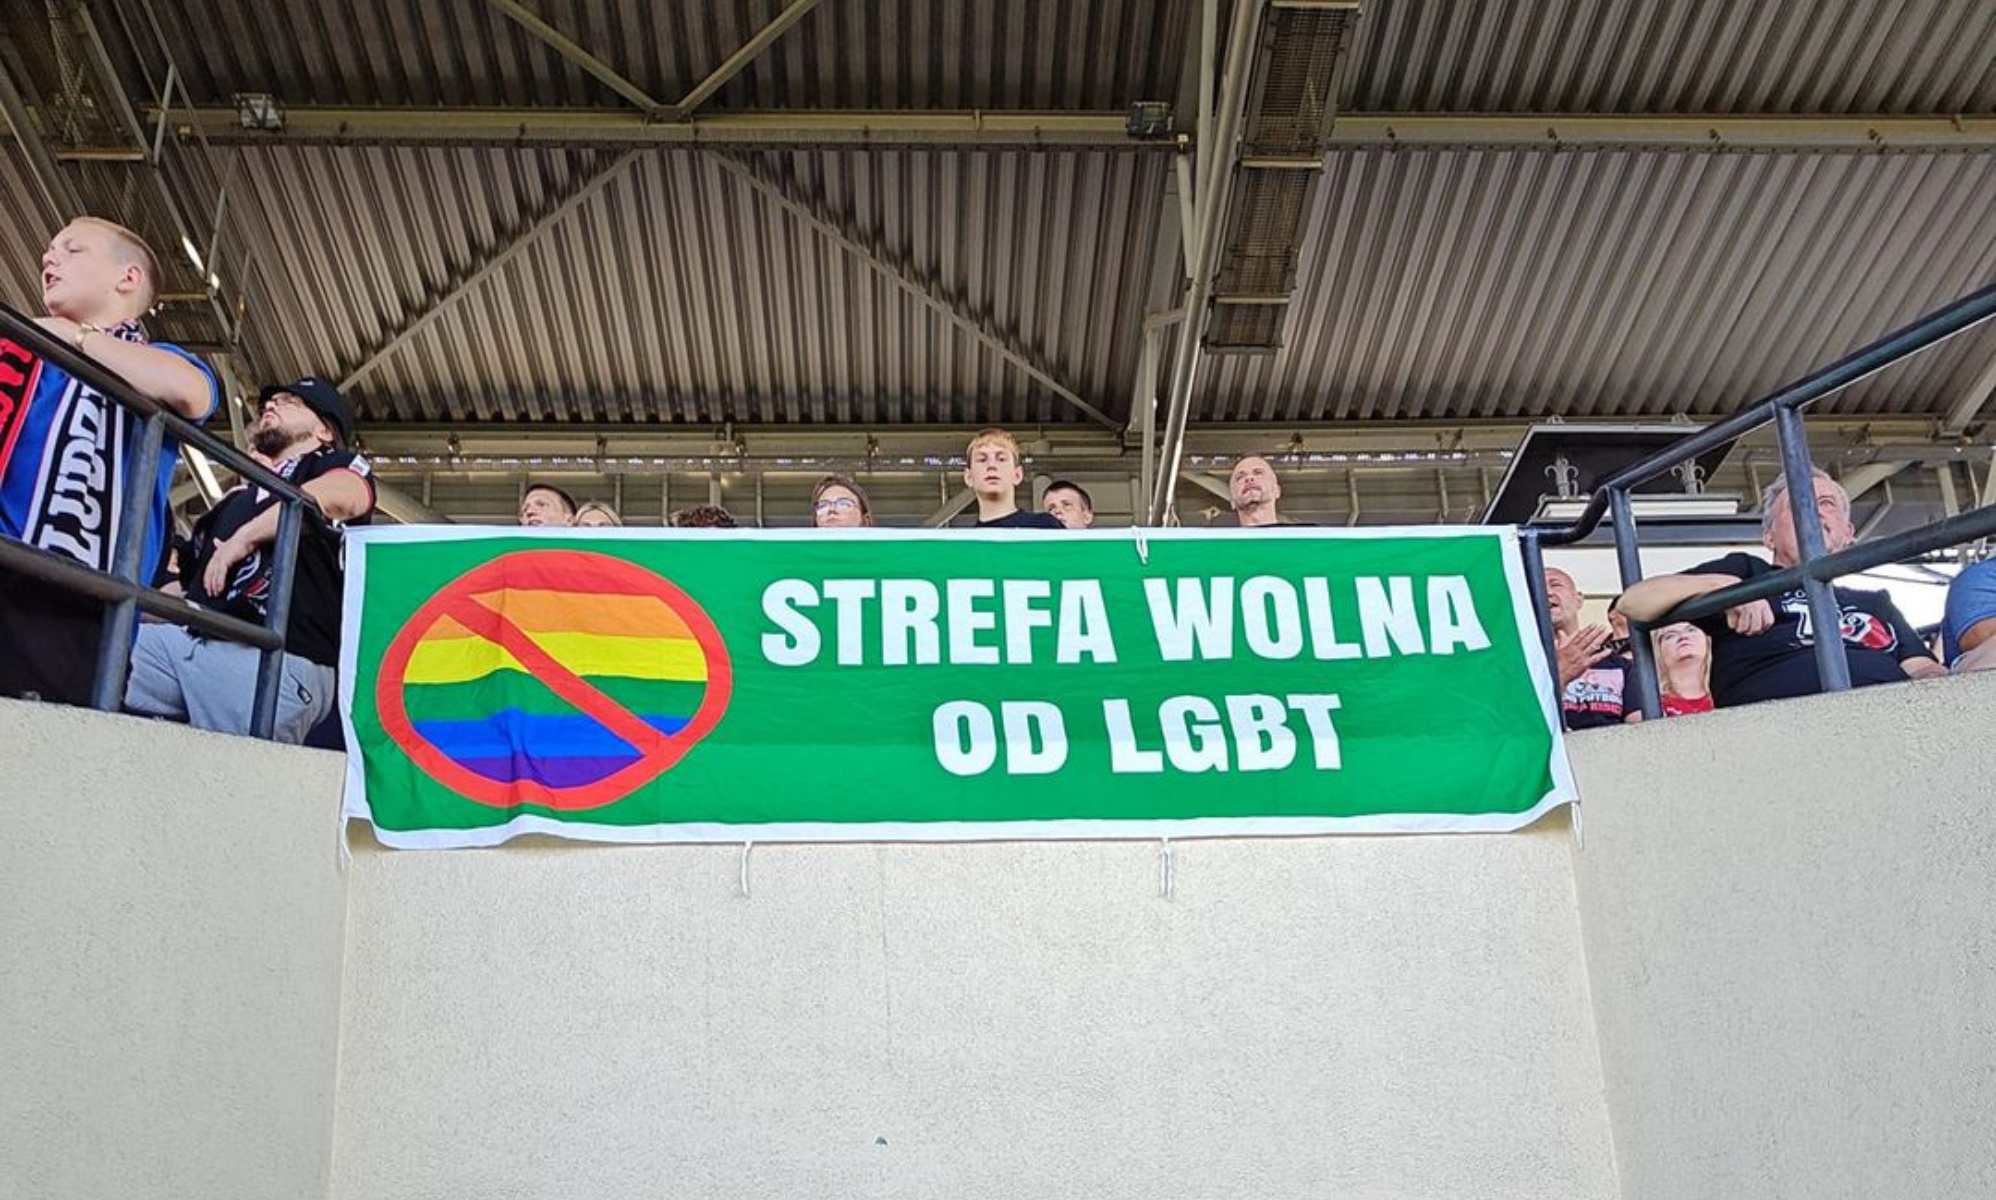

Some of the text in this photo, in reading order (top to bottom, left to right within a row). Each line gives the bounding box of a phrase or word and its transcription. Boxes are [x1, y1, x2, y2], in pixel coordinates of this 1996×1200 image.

[761, 575, 1491, 666] STREFA WOLNA
[932, 694, 1343, 775] OD LGBT
